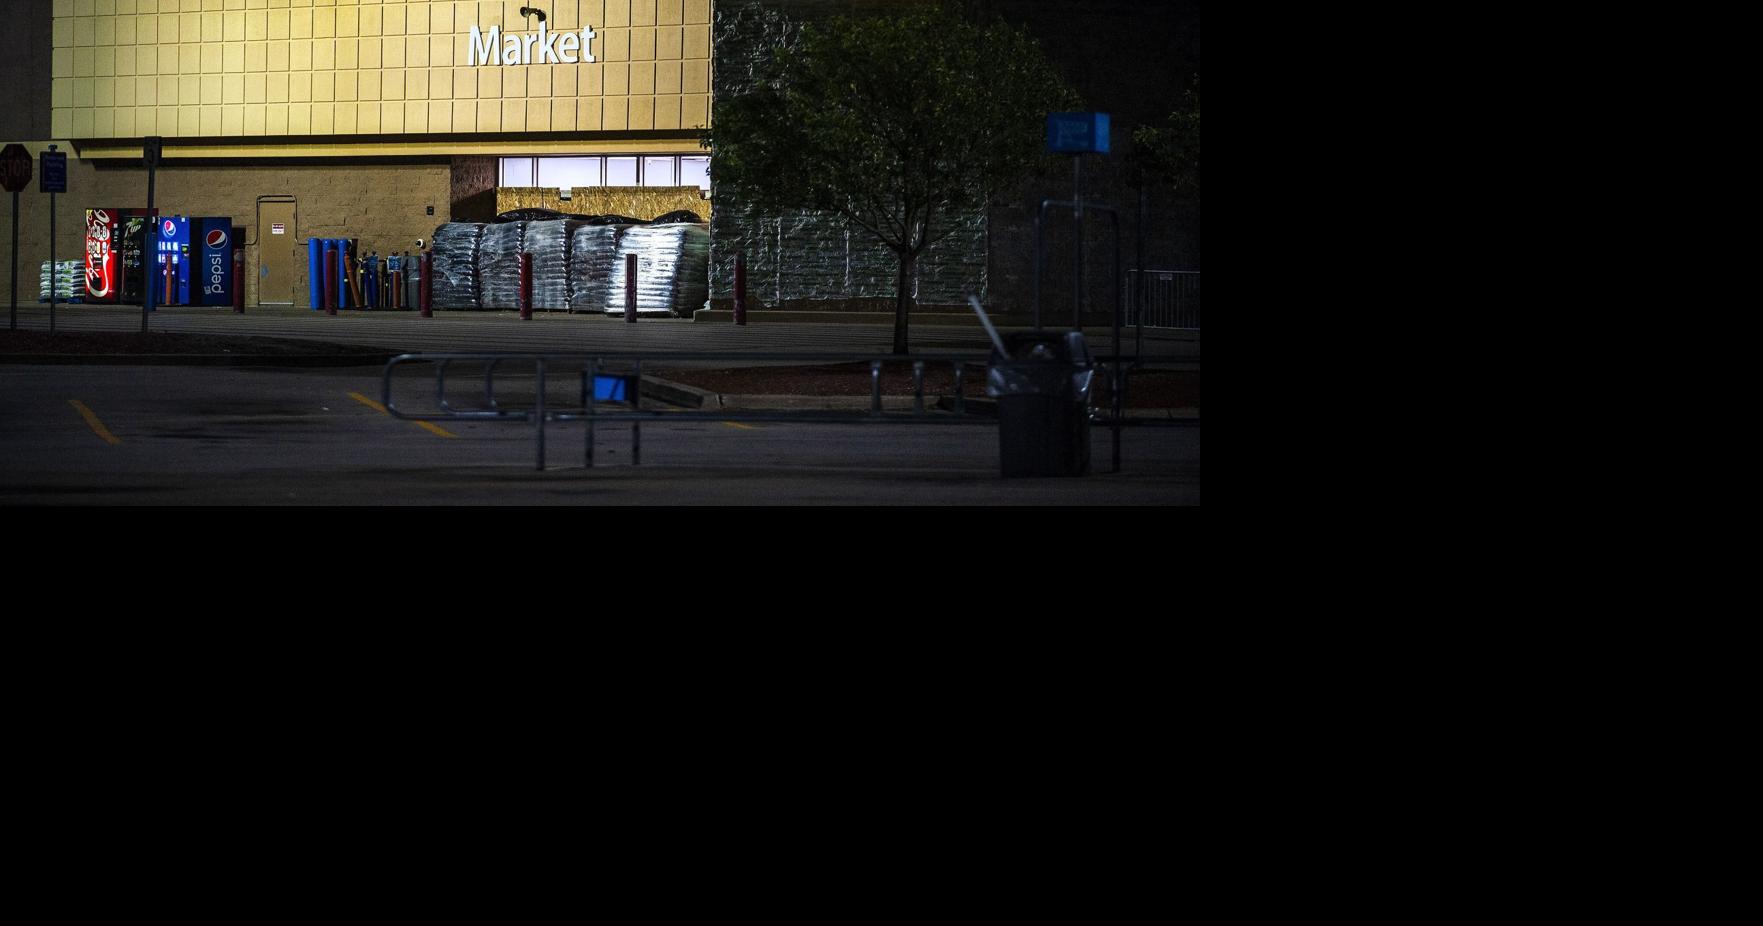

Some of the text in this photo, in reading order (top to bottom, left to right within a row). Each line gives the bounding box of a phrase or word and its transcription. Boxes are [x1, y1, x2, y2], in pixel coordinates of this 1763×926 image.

[468, 21, 596, 66] Market
[0, 159, 30, 177] STOP
[209, 253, 225, 294] pepsi
